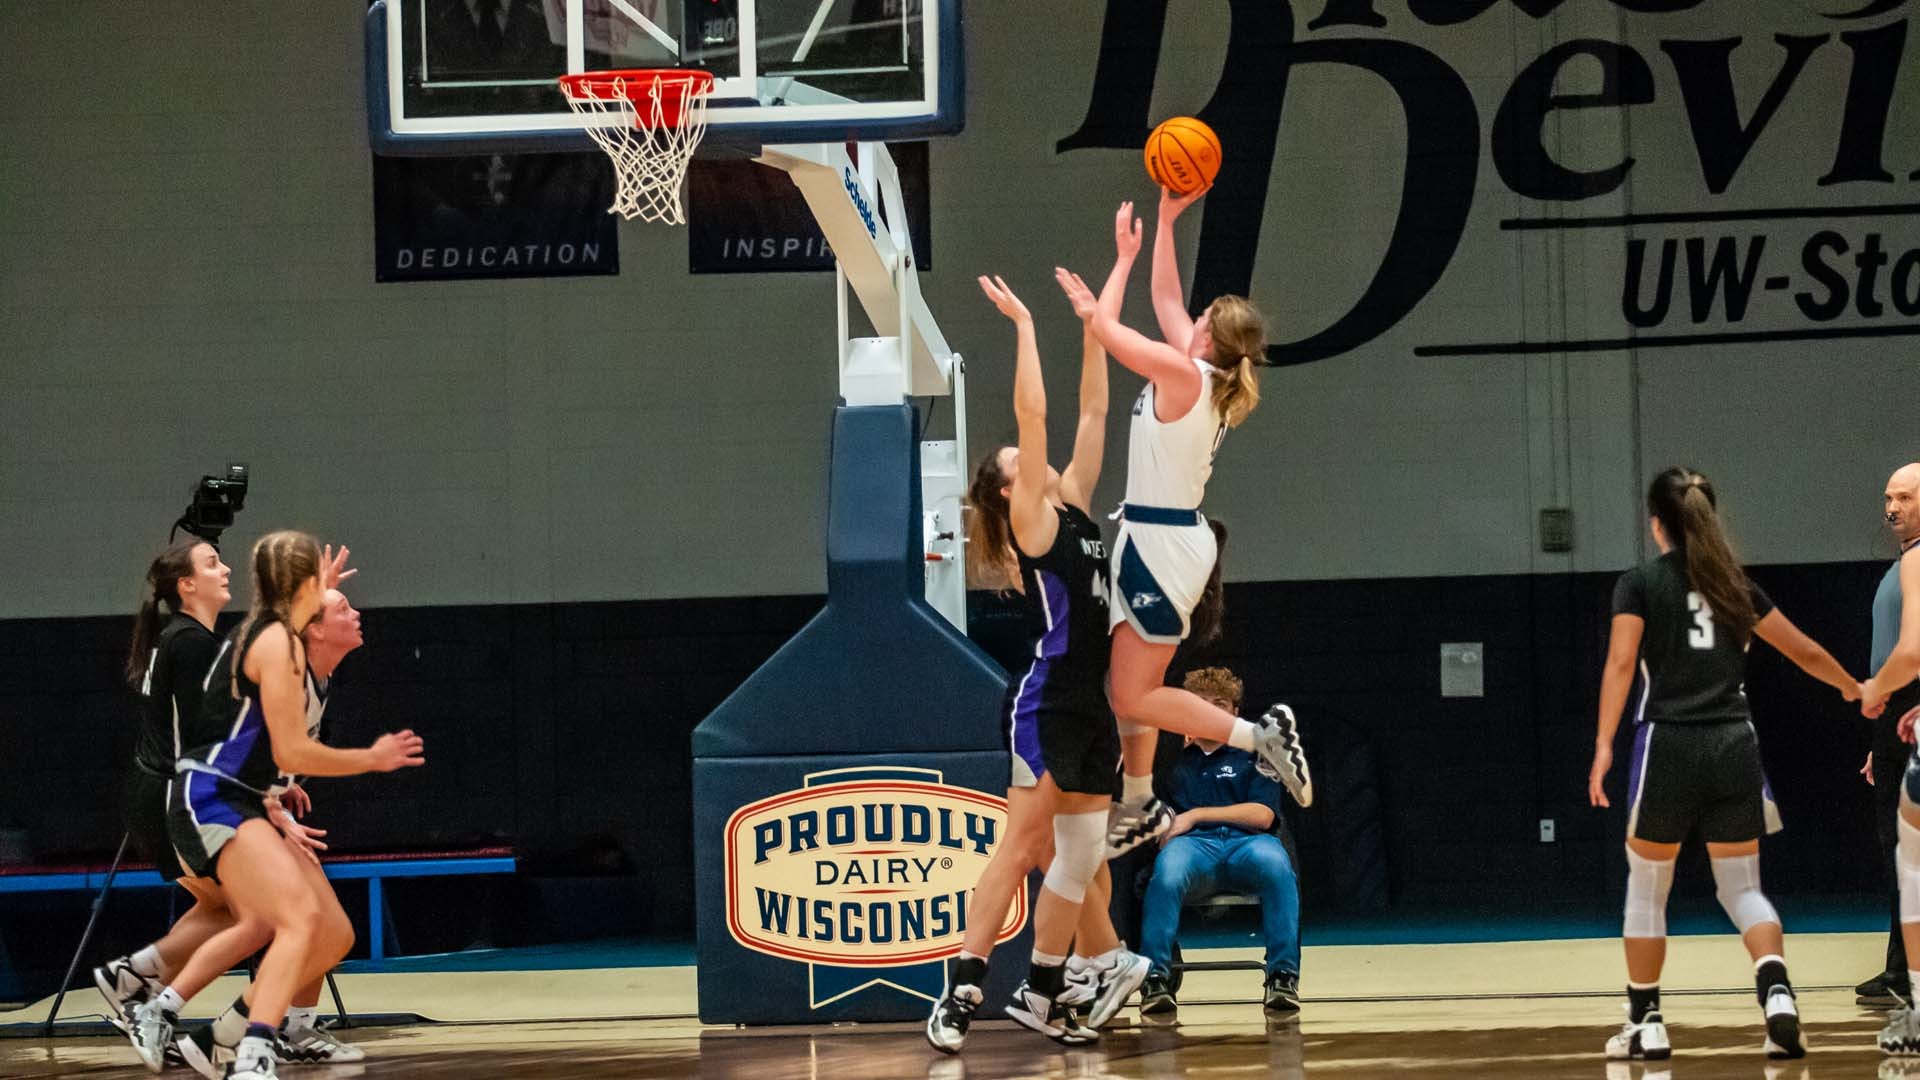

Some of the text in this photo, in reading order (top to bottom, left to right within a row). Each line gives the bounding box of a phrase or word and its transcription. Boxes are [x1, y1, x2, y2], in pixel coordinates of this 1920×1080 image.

[844, 166, 876, 240] Schelde
[1190, 17, 1920, 367] Devi
[396, 243, 600, 269] DEDICATION
[1687, 591, 1714, 649] 3
[753, 803, 997, 865] PROUDLY
[754, 886, 976, 944] WISCONSI
